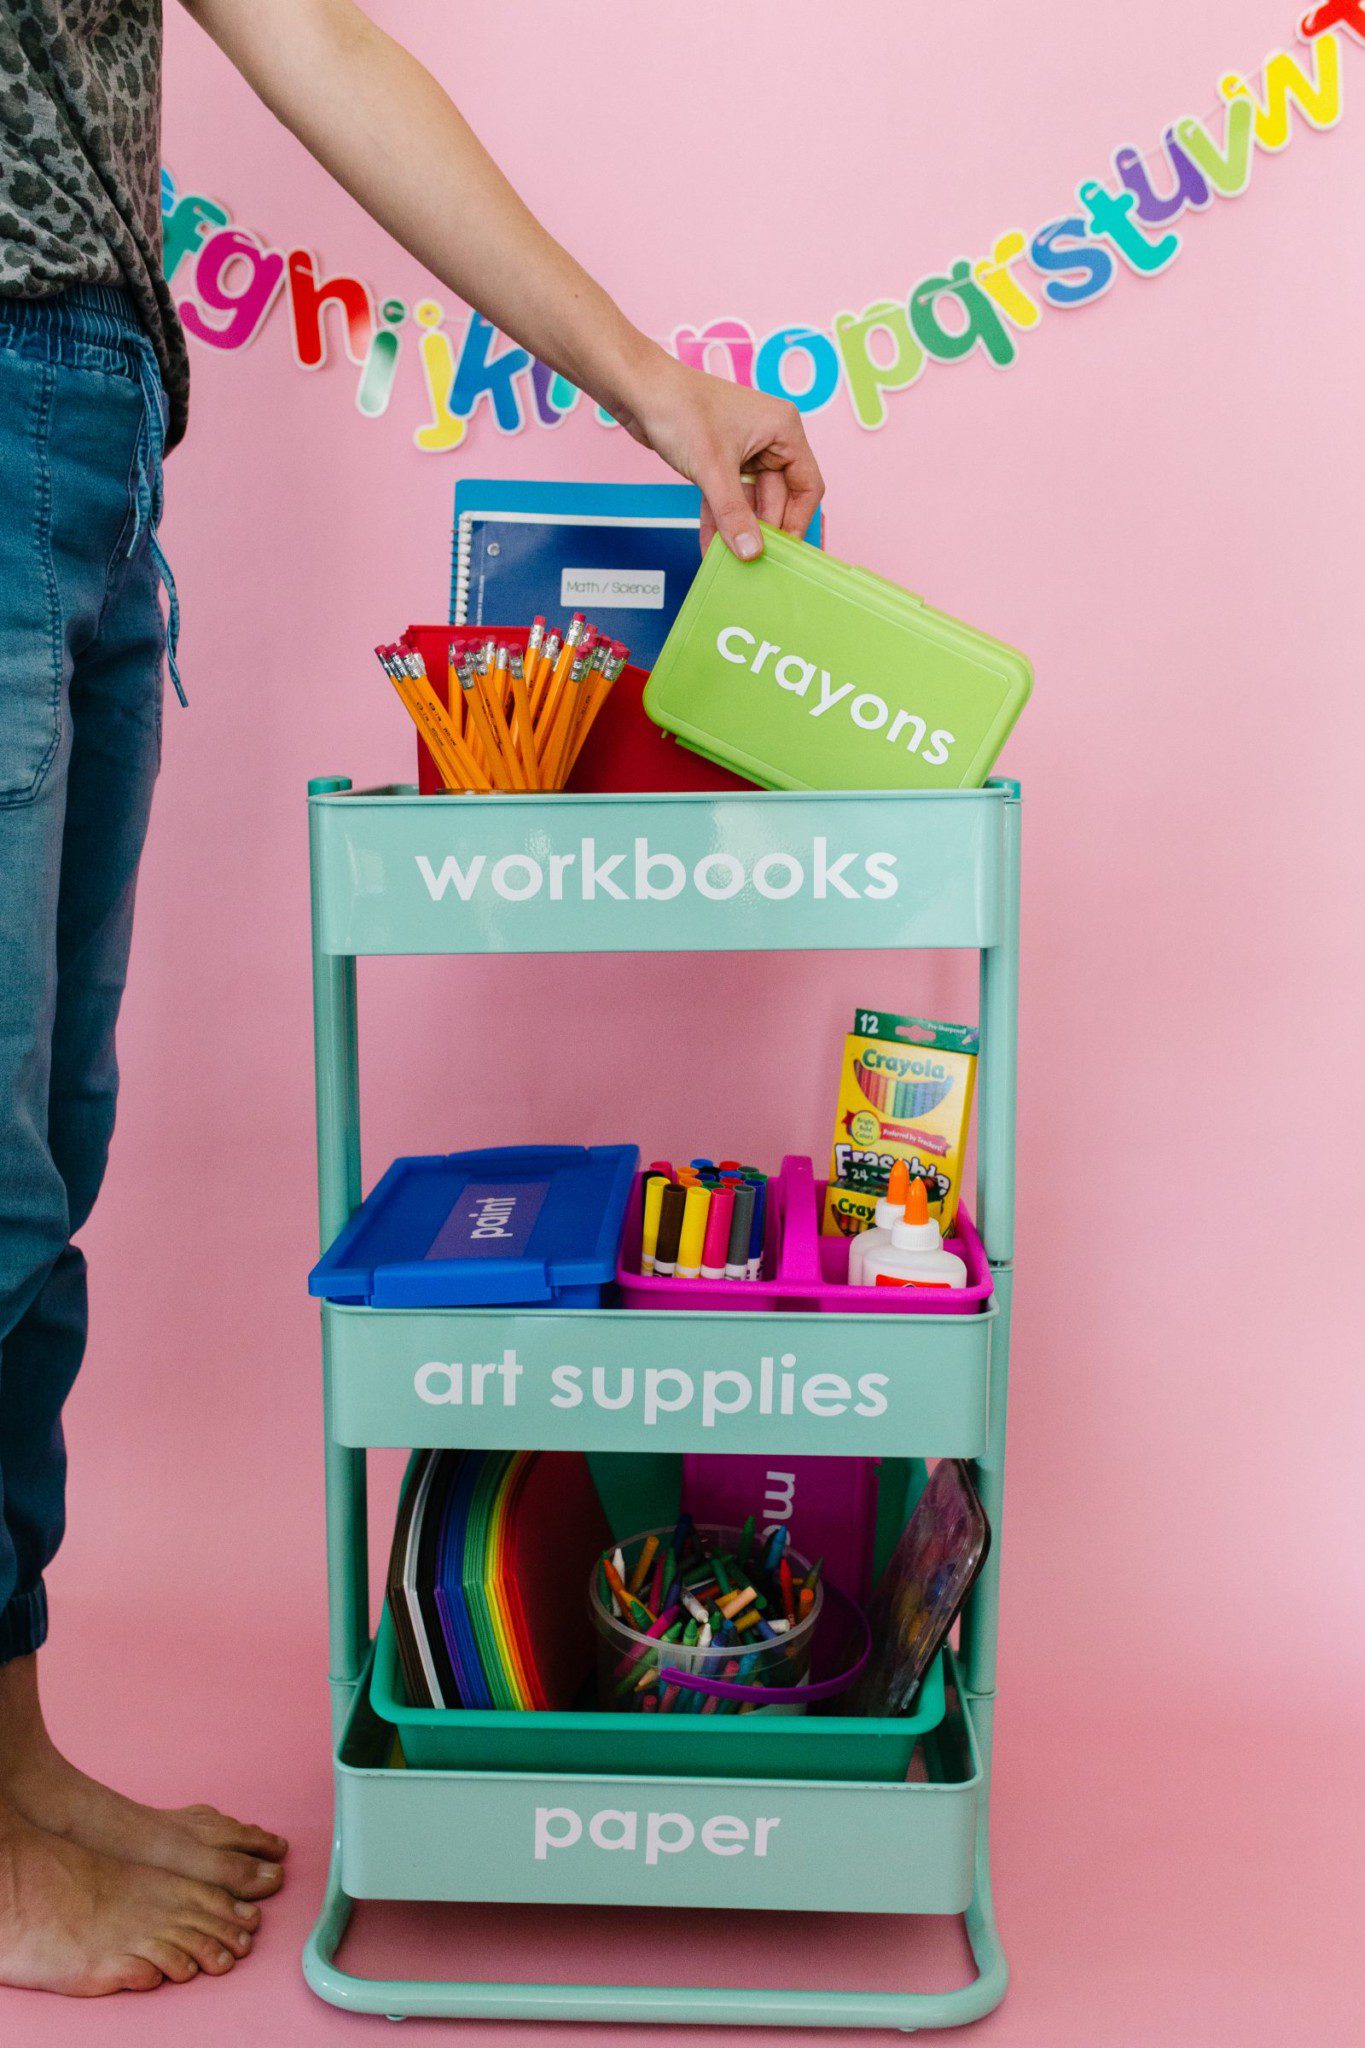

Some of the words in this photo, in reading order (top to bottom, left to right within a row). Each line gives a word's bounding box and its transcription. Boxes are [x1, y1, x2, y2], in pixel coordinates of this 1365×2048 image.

[566, 581, 600, 593] Math
[611, 581, 661, 595] Science
[715, 625, 956, 766] crayons
[414, 836, 899, 902] workbooks
[860, 1013, 879, 1034] 12
[862, 1048, 945, 1079] Crayola
[851, 1168, 869, 1181] 24
[468, 1195, 517, 1239] paint
[837, 1198, 876, 1221] Cray
[413, 1349, 523, 1406] art
[549, 1353, 889, 1428] supplies
[534, 1806, 781, 1866] paper
